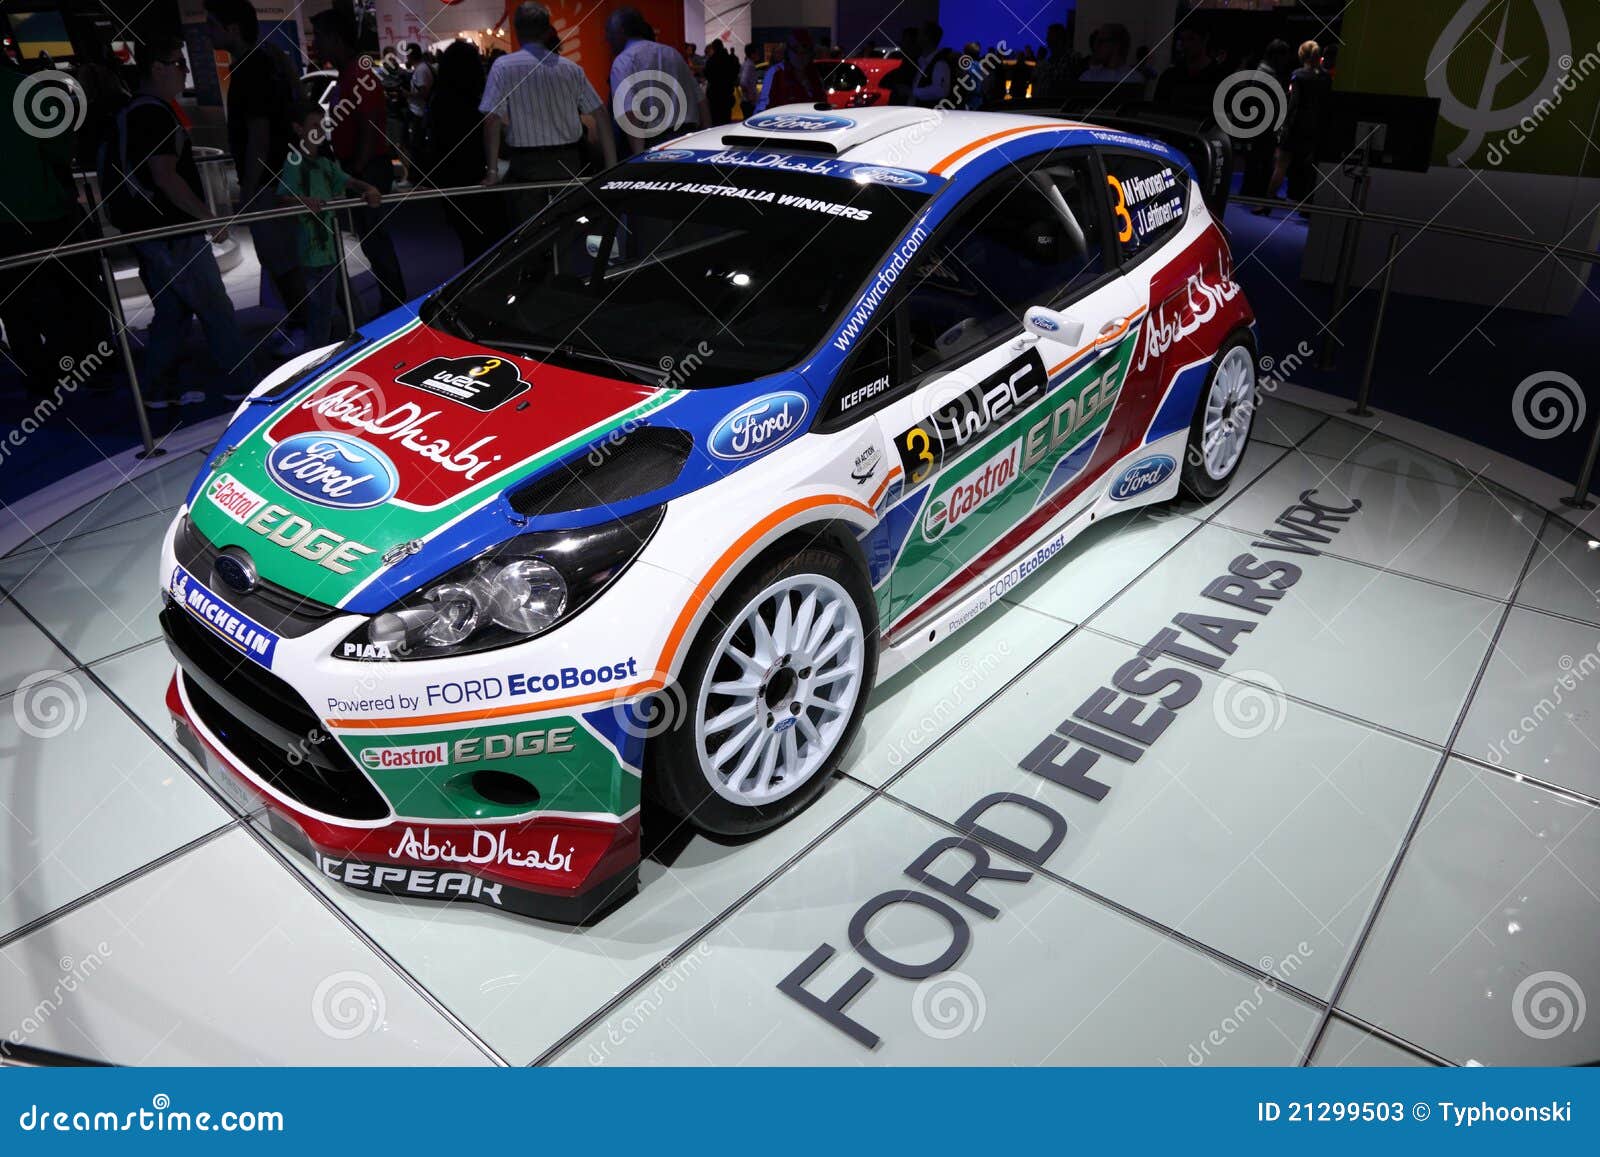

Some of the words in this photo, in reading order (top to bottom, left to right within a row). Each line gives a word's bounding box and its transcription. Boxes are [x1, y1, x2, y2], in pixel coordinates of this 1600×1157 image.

[762, 114, 829, 130] Ford
[600, 180, 632, 191] 2011
[631, 181, 680, 192] RALLY
[678, 182, 775, 203] AUSTRALIA
[777, 194, 873, 221] WINNERS
[1106, 174, 1133, 243] 3
[1121, 178, 1136, 207] M
[1137, 209, 1145, 236] J
[833, 226, 928, 352] www.wrcford.com
[468, 359, 502, 377] 3
[841, 375, 891, 412] ICEPEAK
[730, 401, 793, 452] Ford
[1022, 360, 1121, 474] EDGE
[278, 437, 376, 499] Ford
[906, 428, 935, 484] 3
[1119, 466, 1162, 497] Ford
[214, 480, 262, 519] Castrol
[948, 447, 1018, 525] Castrol
[246, 503, 379, 576] EDGE
[1251, 488, 1362, 557] WRC
[949, 603, 979, 632] Powered
[989, 567, 1019, 602] FORD
[1019, 533, 1066, 582] EcoBoost
[1200, 552, 1303, 615] RS
[187, 588, 271, 656] MICHELIN
[343, 642, 393, 660] PIAA
[327, 694, 396, 714] Powered
[399, 693, 420, 712] by
[425, 677, 504, 707] FORD
[507, 656, 639, 697] EcoBoost
[1017, 612, 1258, 803] FIESTA
[381, 745, 445, 768] Castrol
[453, 726, 578, 765] EDGE
[315, 850, 504, 905] ICEPEAK
[776, 791, 1068, 1050] FORD
